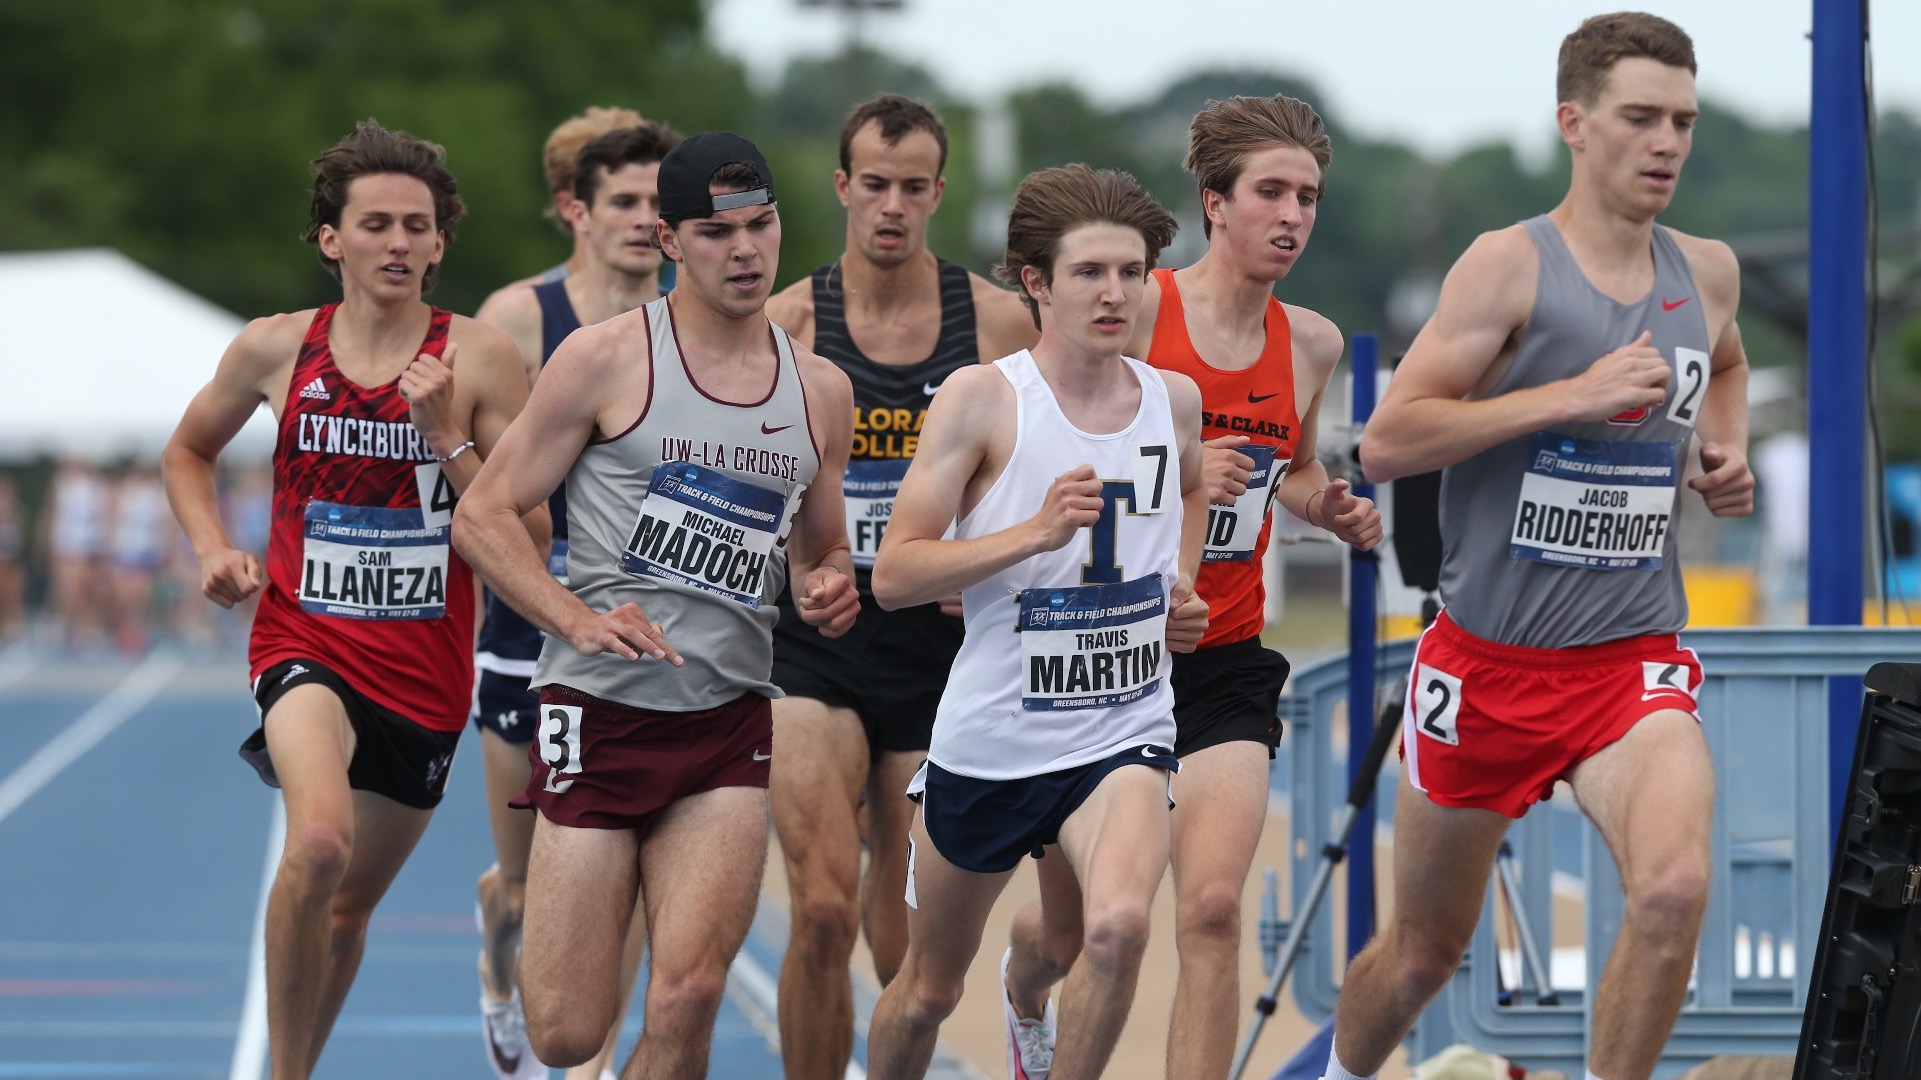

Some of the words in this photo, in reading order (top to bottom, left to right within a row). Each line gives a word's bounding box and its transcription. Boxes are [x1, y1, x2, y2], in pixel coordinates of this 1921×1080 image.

[299, 389, 330, 400] adidas
[1674, 360, 1703, 421] 2
[1215, 414, 1229, 429] &
[1231, 416, 1290, 440] CLARK
[660, 436, 727, 470] UW-LA
[733, 446, 800, 483] CROSSE
[1139, 445, 1168, 509] 7
[1555, 458, 1585, 472] TRACK
[1584, 464, 1592, 473] &
[1592, 464, 1614, 475] FIELD
[1614, 465, 1671, 477] CHAMPIONSHIPS
[430, 466, 458, 519] 4
[676, 483, 701, 500] TRACK
[700, 491, 708, 501] &
[707, 493, 730, 511] FIELD
[729, 503, 776, 523] CHAMPIONSHIPS
[1578, 488, 1629, 508] JACOB
[327, 525, 350, 536] TRACK
[350, 527, 357, 537] &
[357, 527, 379, 539] FIELD
[380, 528, 443, 539] CHAMPIONSHIPS
[681, 510, 746, 547] MICHAEL
[1516, 500, 1668, 551] RIDDERHOFF
[358, 550, 392, 566] SAM
[628, 514, 766, 595] MADOCH
[304, 559, 445, 606] LLANEZA
[1049, 610, 1077, 621] TRACK
[1076, 610, 1084, 620] &
[1084, 608, 1106, 620] FIELD
[1106, 596, 1162, 618] CHAMPIONSHIPS
[1075, 629, 1129, 650] TRAVIS
[1030, 640, 1161, 693] MARTIN
[1053, 697, 1097, 708] GREENSBORO,
[1098, 696, 1108, 705] NC
[1118, 692, 1132, 704] MAY
[1423, 678, 1451, 739] 2
[547, 708, 570, 771] 3
